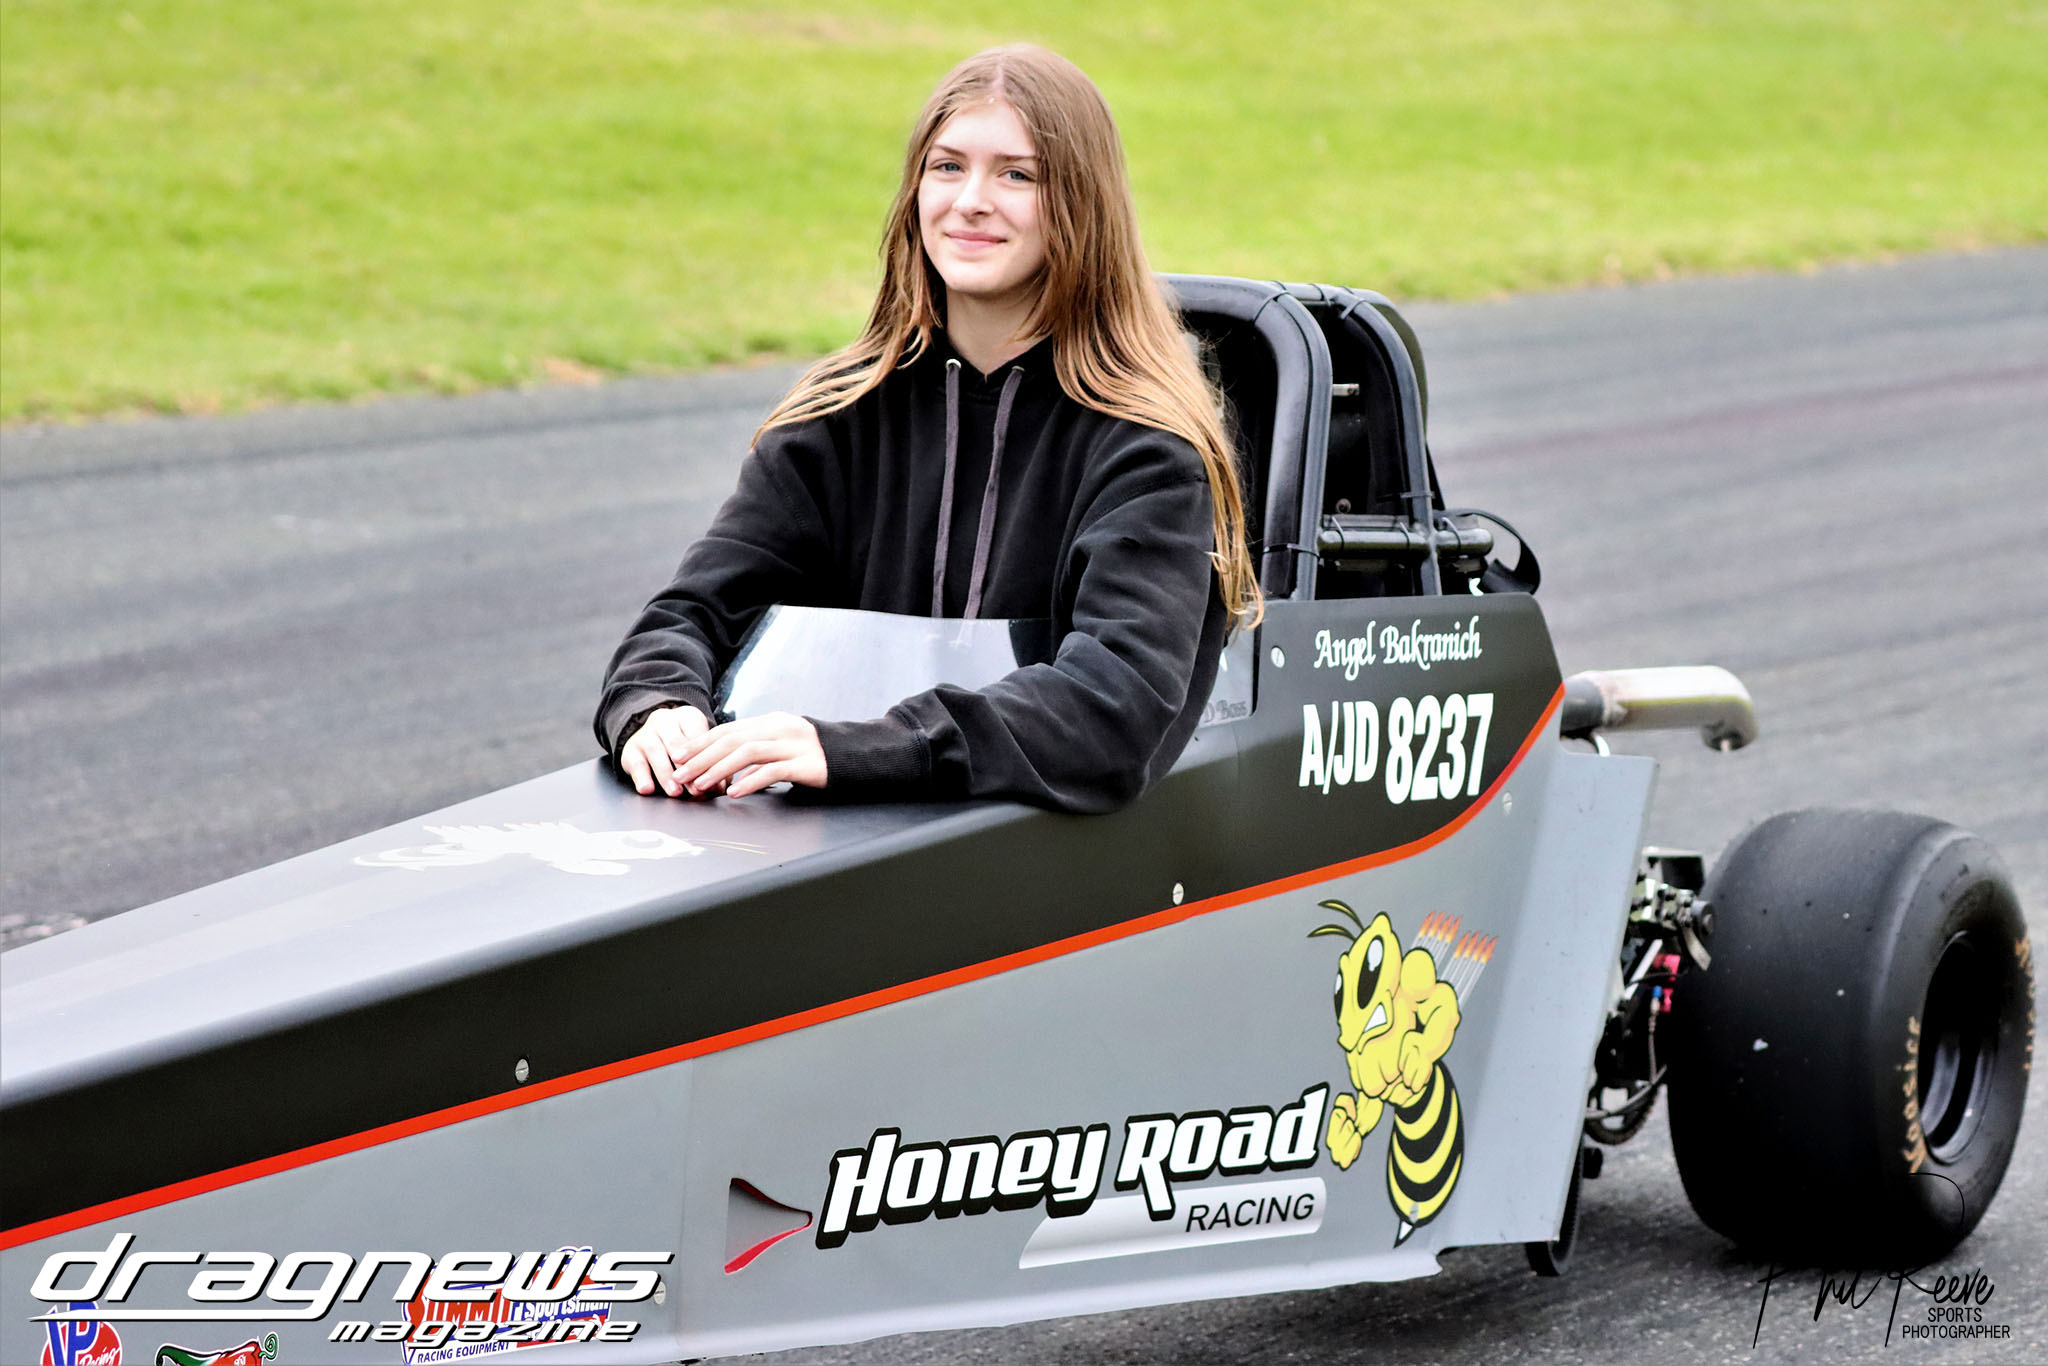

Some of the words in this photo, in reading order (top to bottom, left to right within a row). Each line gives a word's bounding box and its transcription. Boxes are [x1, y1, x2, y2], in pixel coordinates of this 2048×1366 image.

[1313, 619, 1376, 681] Angel
[1379, 615, 1482, 671] Bakranich
[1299, 700, 1379, 795] A/JD
[1385, 693, 1494, 805] 8237
[816, 1126, 1110, 1249] Honey
[1114, 1081, 1331, 1221] Road
[1185, 1193, 1314, 1233] RACING
[417, 1347, 453, 1364] RACING
[455, 1340, 510, 1358] EQUIPMENT
